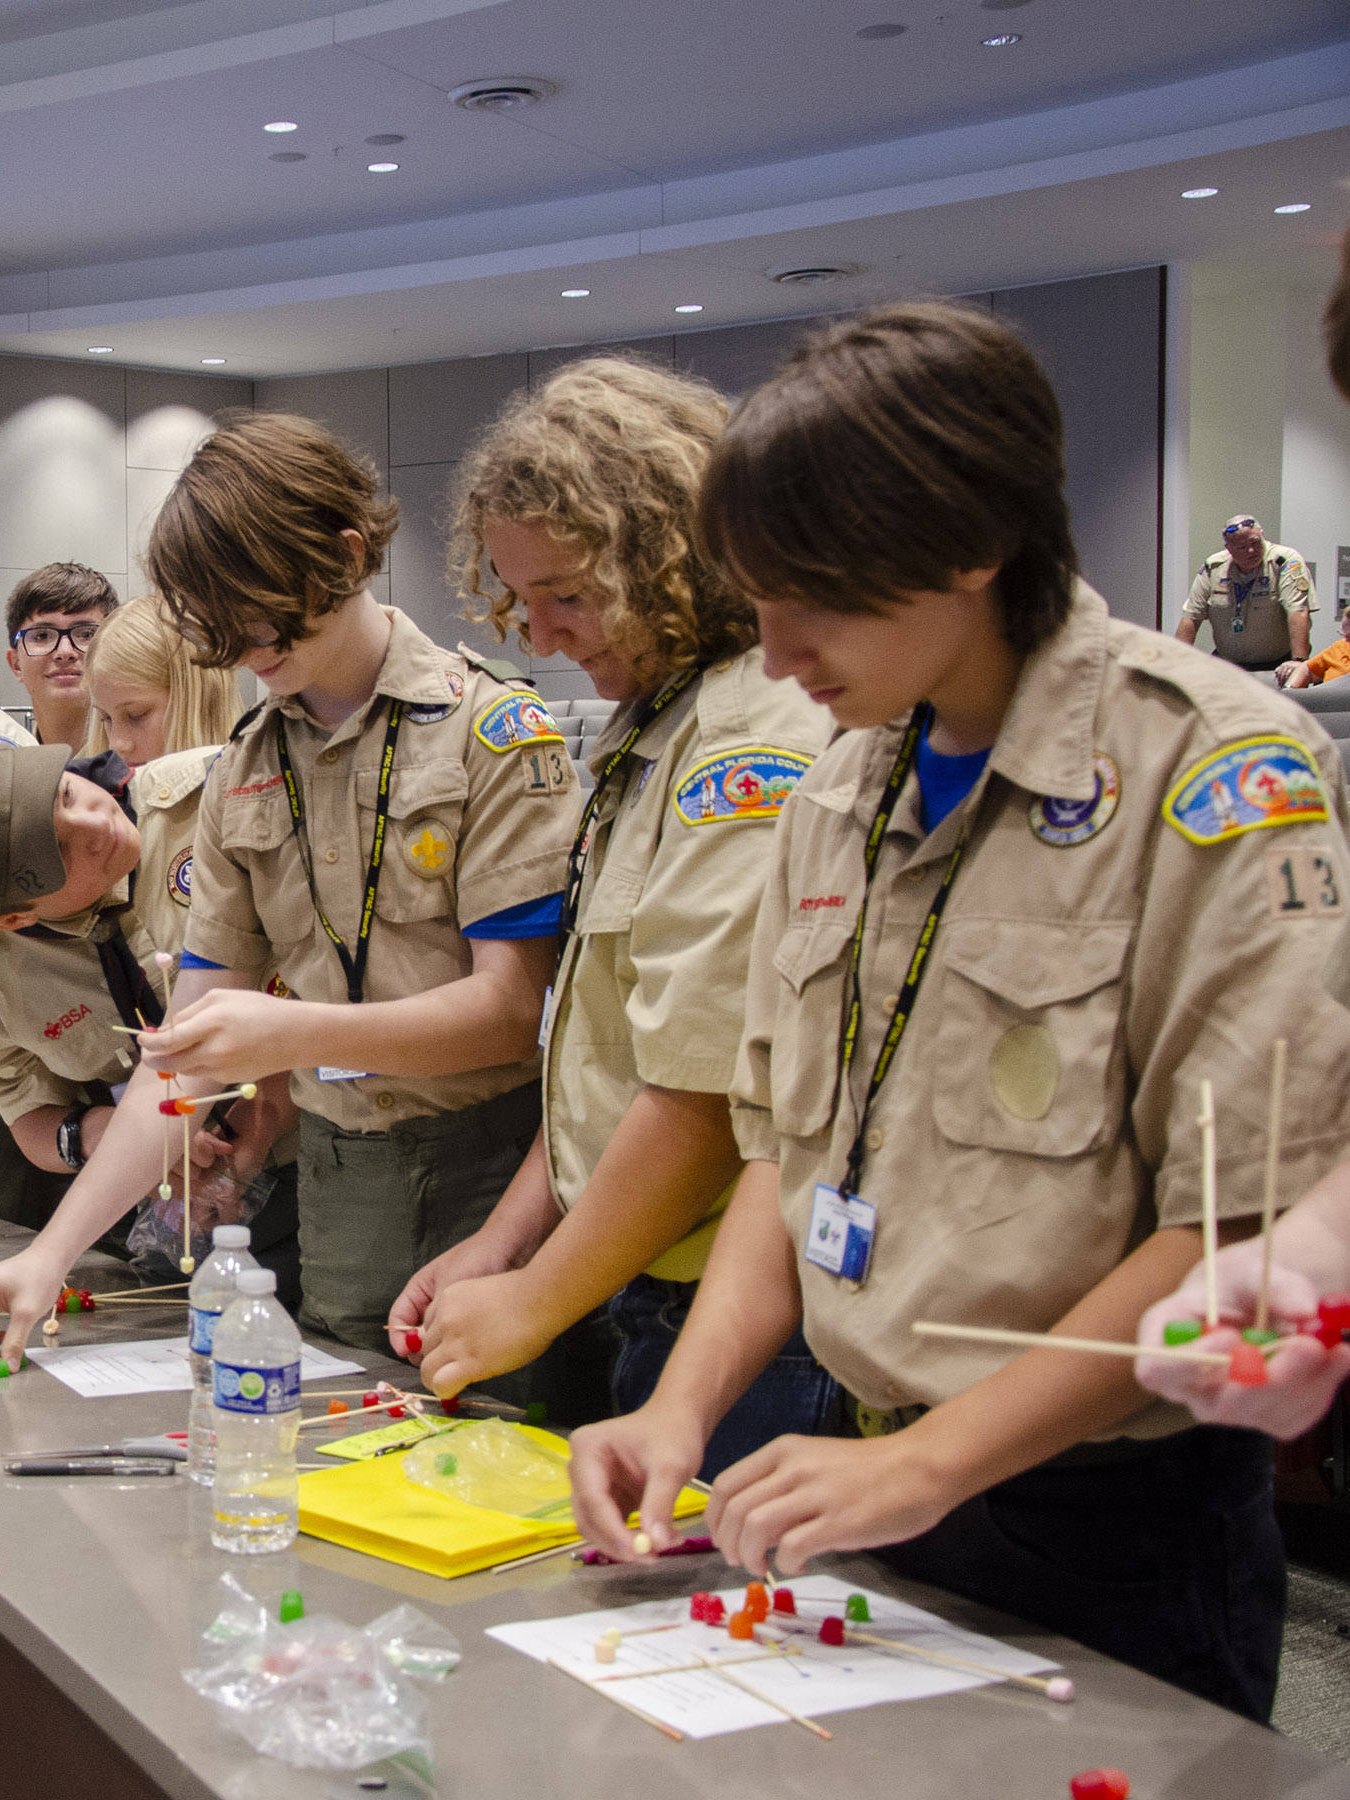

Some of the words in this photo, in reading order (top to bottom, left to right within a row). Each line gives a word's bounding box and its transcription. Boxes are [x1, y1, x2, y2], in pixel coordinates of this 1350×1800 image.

[654, 688, 674, 710] AFTAC
[484, 702, 516, 731] CENTRAL
[382, 746, 393, 770] AFTAC
[604, 750, 622, 776] AFTAC
[620, 726, 640, 753] Security
[379, 768, 390, 795] Security
[680, 763, 724, 797] CENTRAL
[724, 756, 776, 770] FLORIDA
[776, 758, 809, 771] COUN
[376, 815, 385, 839] AFTAC
[372, 838, 383, 867] Security
[366, 886, 375, 911] AFTAC
[360, 910, 372, 938] Security
[61, 1004, 92, 1028] BSA
